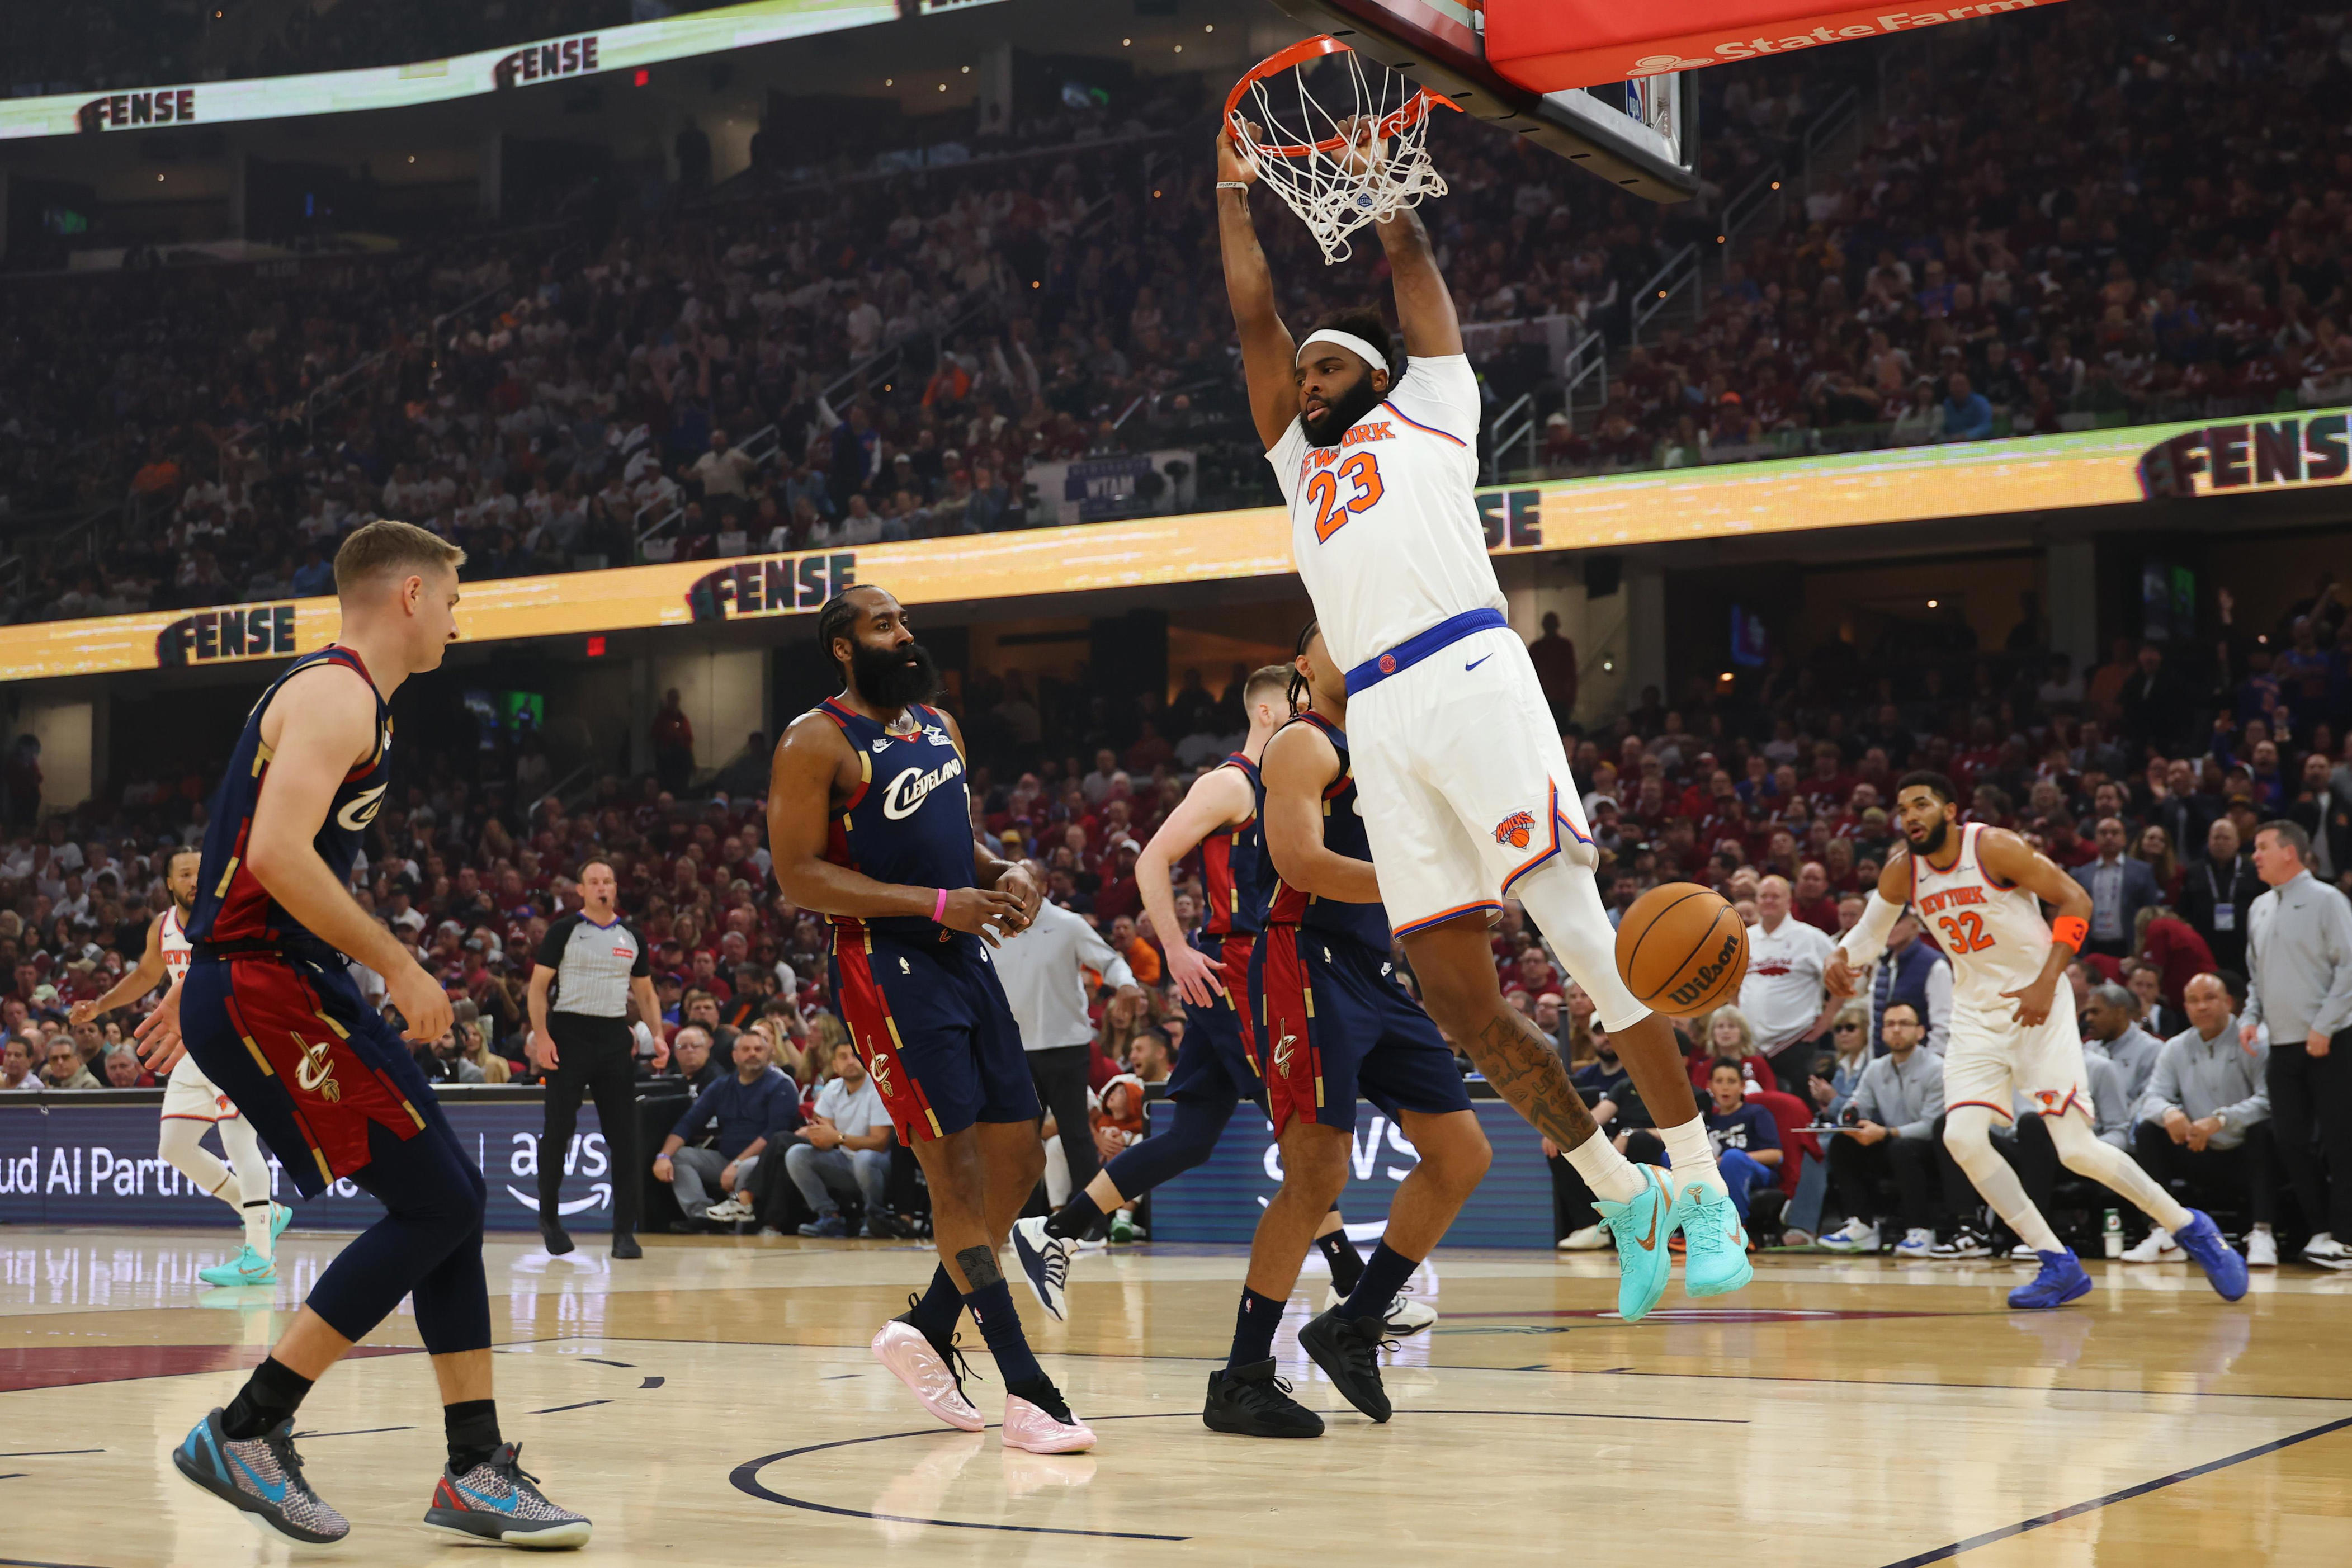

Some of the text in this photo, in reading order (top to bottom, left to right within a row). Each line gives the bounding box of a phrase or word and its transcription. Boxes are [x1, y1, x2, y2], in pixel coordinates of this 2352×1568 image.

[1714, 0, 2038, 60] State Farm
[1301, 421, 1395, 480] EW ORK
[1307, 451, 1385, 545] 23
[872, 739, 888, 748] NIKE
[929, 735, 950, 744] CLIFFS
[1496, 811, 1536, 843] KNICKS
[1919, 885, 1989, 917] NEW YORK
[1938, 910, 1996, 955] 32
[1668, 933, 1739, 1005] Wilson
[46, 1147, 81, 1195] AI
[91, 1146, 236, 1197] Partn
